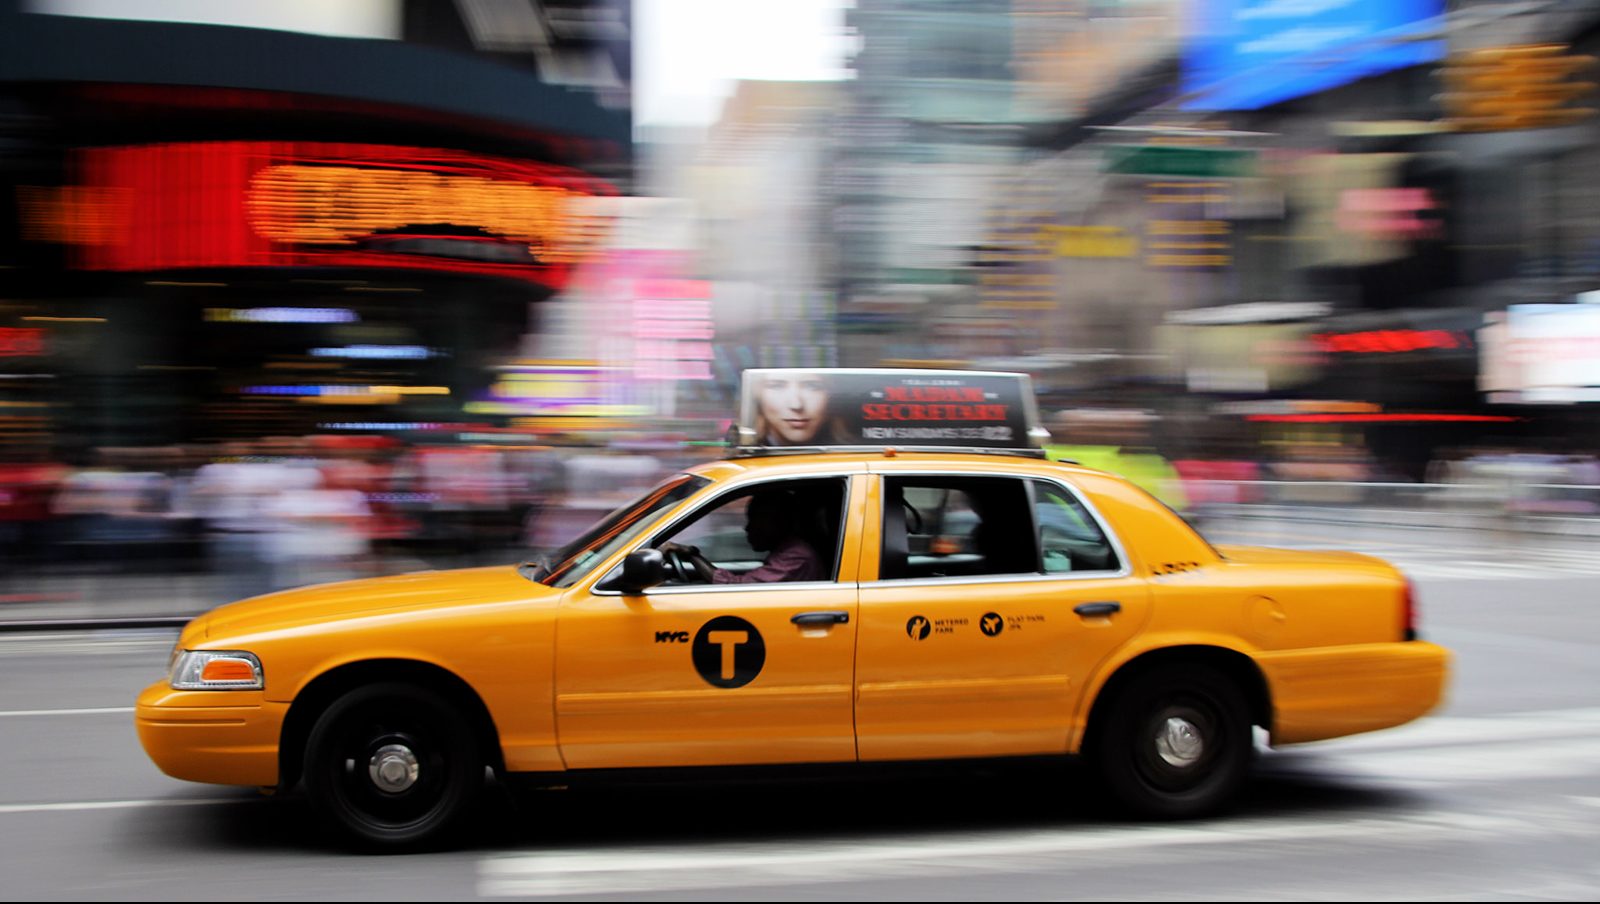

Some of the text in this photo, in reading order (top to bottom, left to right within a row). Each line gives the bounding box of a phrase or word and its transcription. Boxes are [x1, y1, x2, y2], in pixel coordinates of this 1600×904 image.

[884, 387, 985, 401] MADAM
[862, 403, 1009, 420] SECRETARY
[862, 427, 896, 438] NEW
[935, 618, 969, 626] METERED
[935, 626, 954, 634] FARE
[655, 630, 749, 680] NYC T
